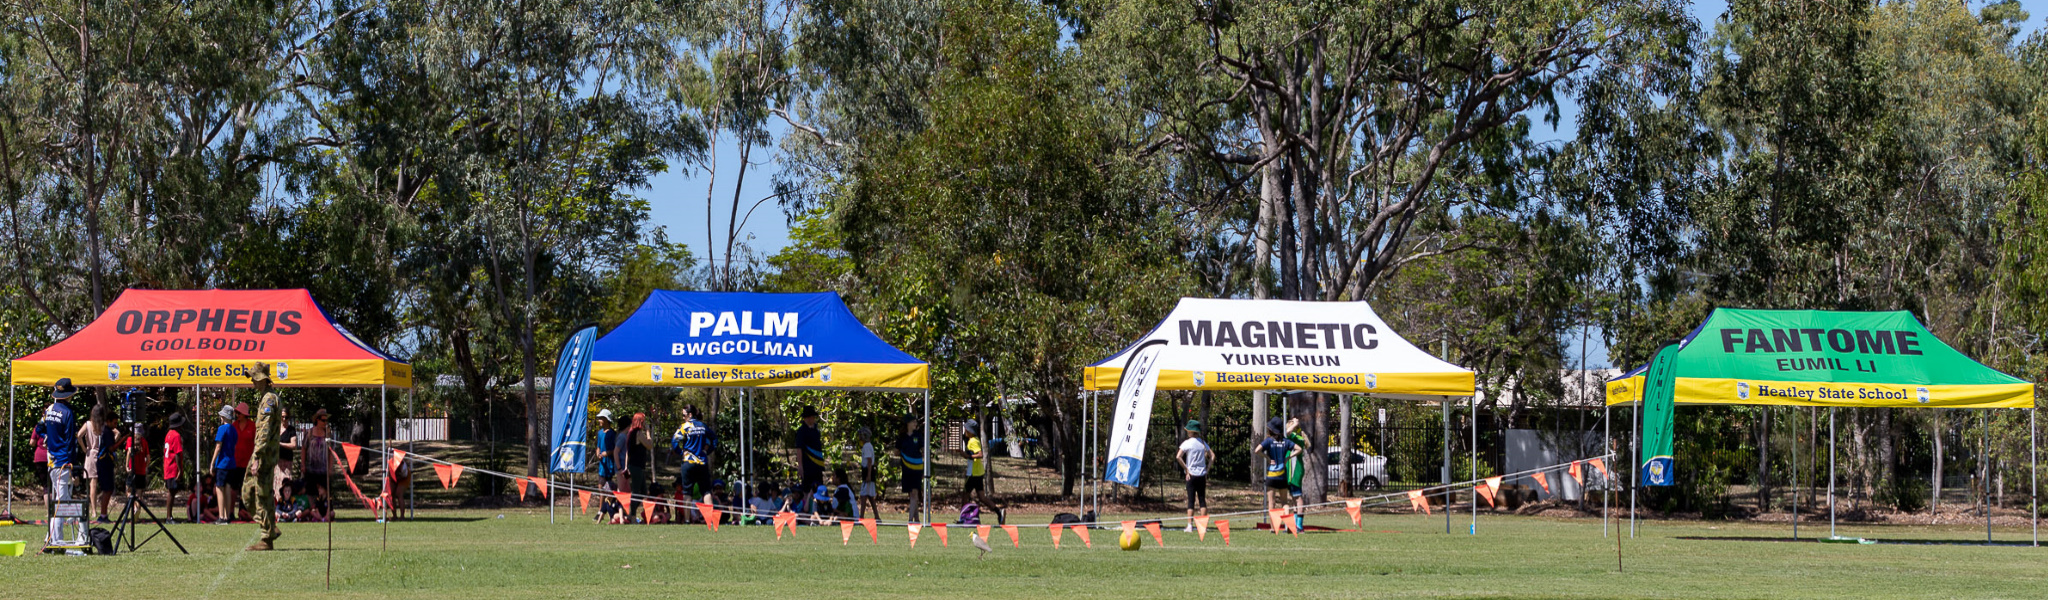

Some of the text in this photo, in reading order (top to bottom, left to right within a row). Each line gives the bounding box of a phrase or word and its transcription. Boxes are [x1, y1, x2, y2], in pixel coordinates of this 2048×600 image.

[116, 308, 302, 335] ORPHEUS
[689, 310, 799, 338] PALM
[1178, 319, 1379, 350] MAGNETIC
[1720, 328, 1923, 356] FANTOME
[140, 338, 266, 352] GOOLBODDI
[671, 339, 813, 358] BWGCOLMAN
[1221, 353, 1341, 367] YUNBENUN
[1776, 357, 1877, 373] EUMIL LI
[131, 364, 271, 380] Heatley State Schl
[673, 367, 815, 383] Heatley State School
[1216, 372, 1360, 386] Heatley State School
[1656, 355, 1664, 412] EUMIL
[1125, 356, 1149, 443] YUNBENUN
[1758, 385, 1909, 401] Heatley State School
